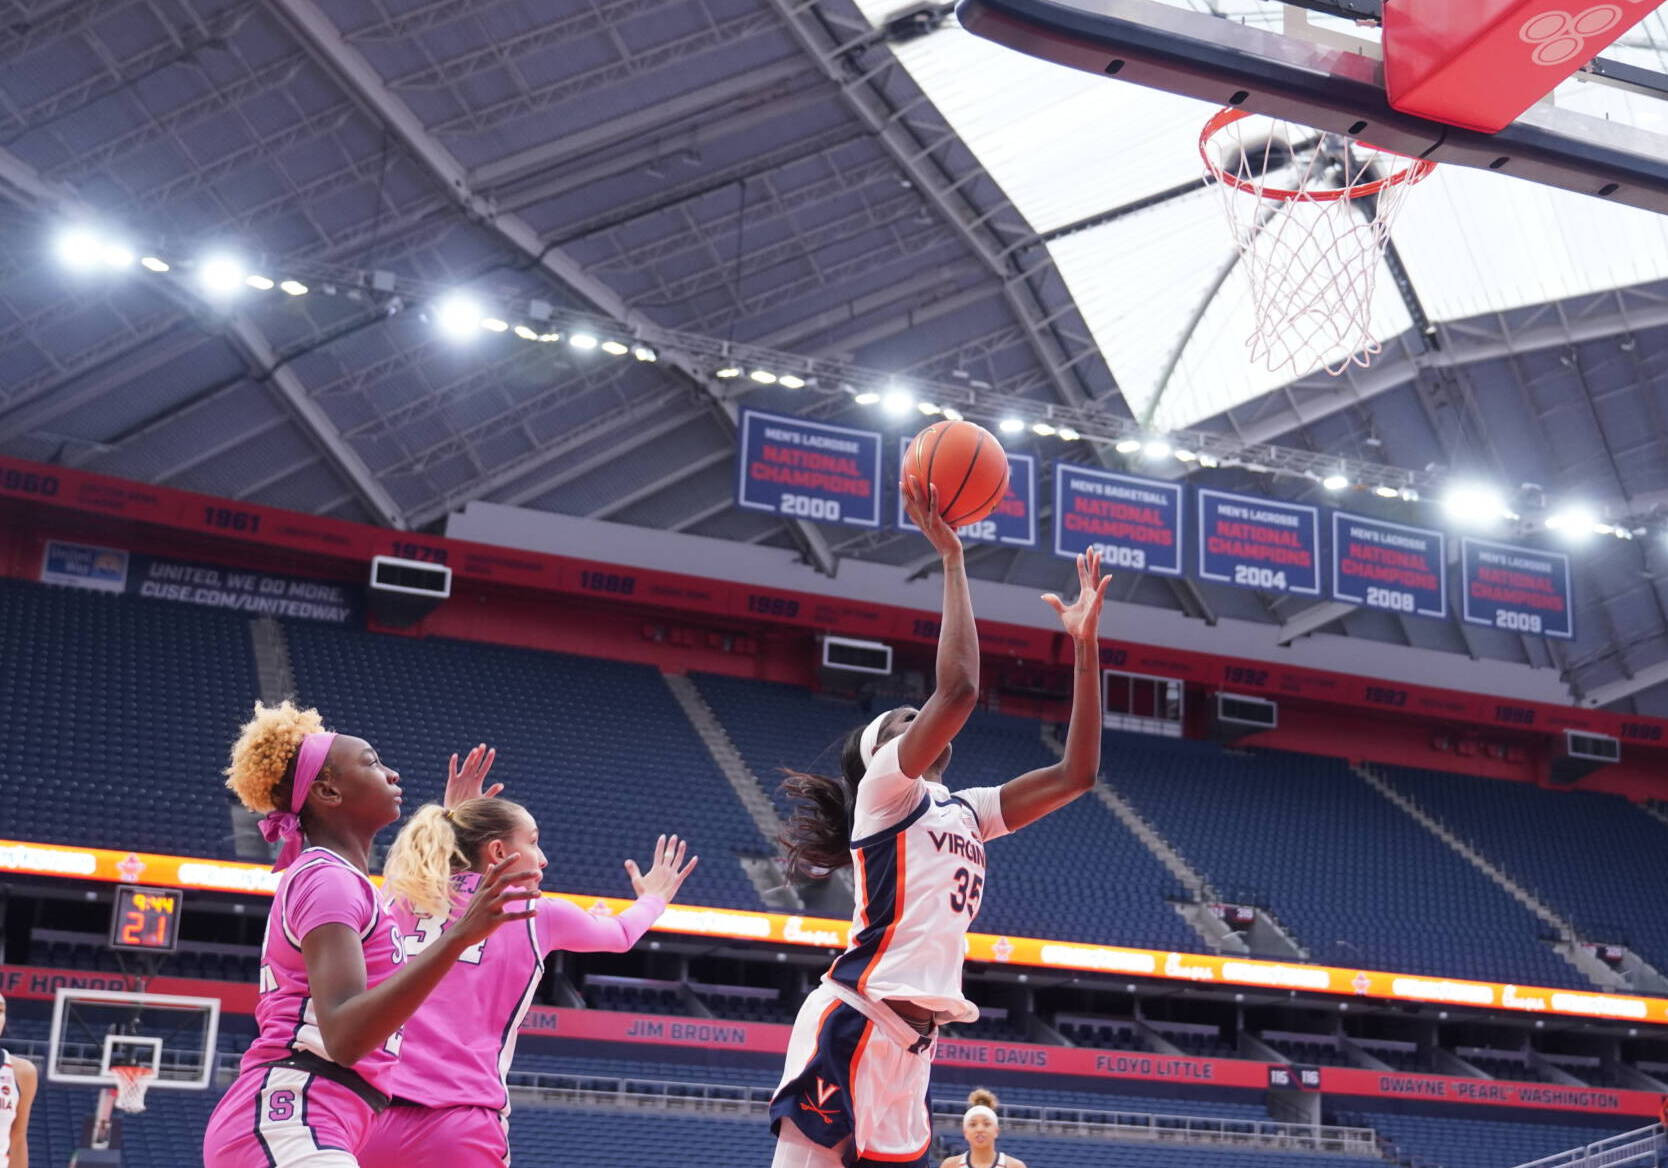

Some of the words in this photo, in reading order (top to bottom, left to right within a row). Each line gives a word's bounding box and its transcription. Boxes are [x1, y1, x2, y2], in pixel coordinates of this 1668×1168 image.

[765, 427, 801, 444] MEN'S
[803, 435, 859, 453] LACROSSE
[763, 444, 860, 477] NATIONAL
[751, 461, 871, 498] CHAMPIONS
[1071, 478, 1102, 496] MEN'S
[1104, 484, 1168, 506] BASKETBALL
[781, 493, 840, 520] 2000
[1074, 496, 1164, 526] NATIONAL
[1217, 504, 1248, 520] MEN'S
[1249, 509, 1299, 528] LACROSSE
[204, 506, 261, 535] 1961
[1064, 513, 1173, 546] CHAMPIONS
[1216, 520, 1301, 547] NATIONAL
[1093, 544, 1145, 568] 2003
[1208, 536, 1312, 567] CHAMPIONS
[1349, 544, 1430, 571] NATIONAL
[227, 572, 256, 590] WE
[260, 578, 286, 595] DO
[1235, 565, 1288, 589] 2004
[1341, 559, 1438, 591] CHAMPIONS
[1478, 567, 1556, 593] NATIONAL
[1471, 582, 1564, 612] CHAMPIONS
[1496, 609, 1542, 633] 2009
[950, 866, 983, 920] 35
[122, 911, 168, 945] 21
[627, 1020, 664, 1038] JIM
[671, 1023, 745, 1043] BROWN
[995, 1047, 1047, 1067] DAVIS
[1097, 1055, 1151, 1075] FLOYD
[1157, 1060, 1212, 1079] LITTLE
[268, 1090, 296, 1122] S
[1380, 1077, 1446, 1096] DWAYNE
[1519, 1087, 1619, 1109] WASHINGTON
